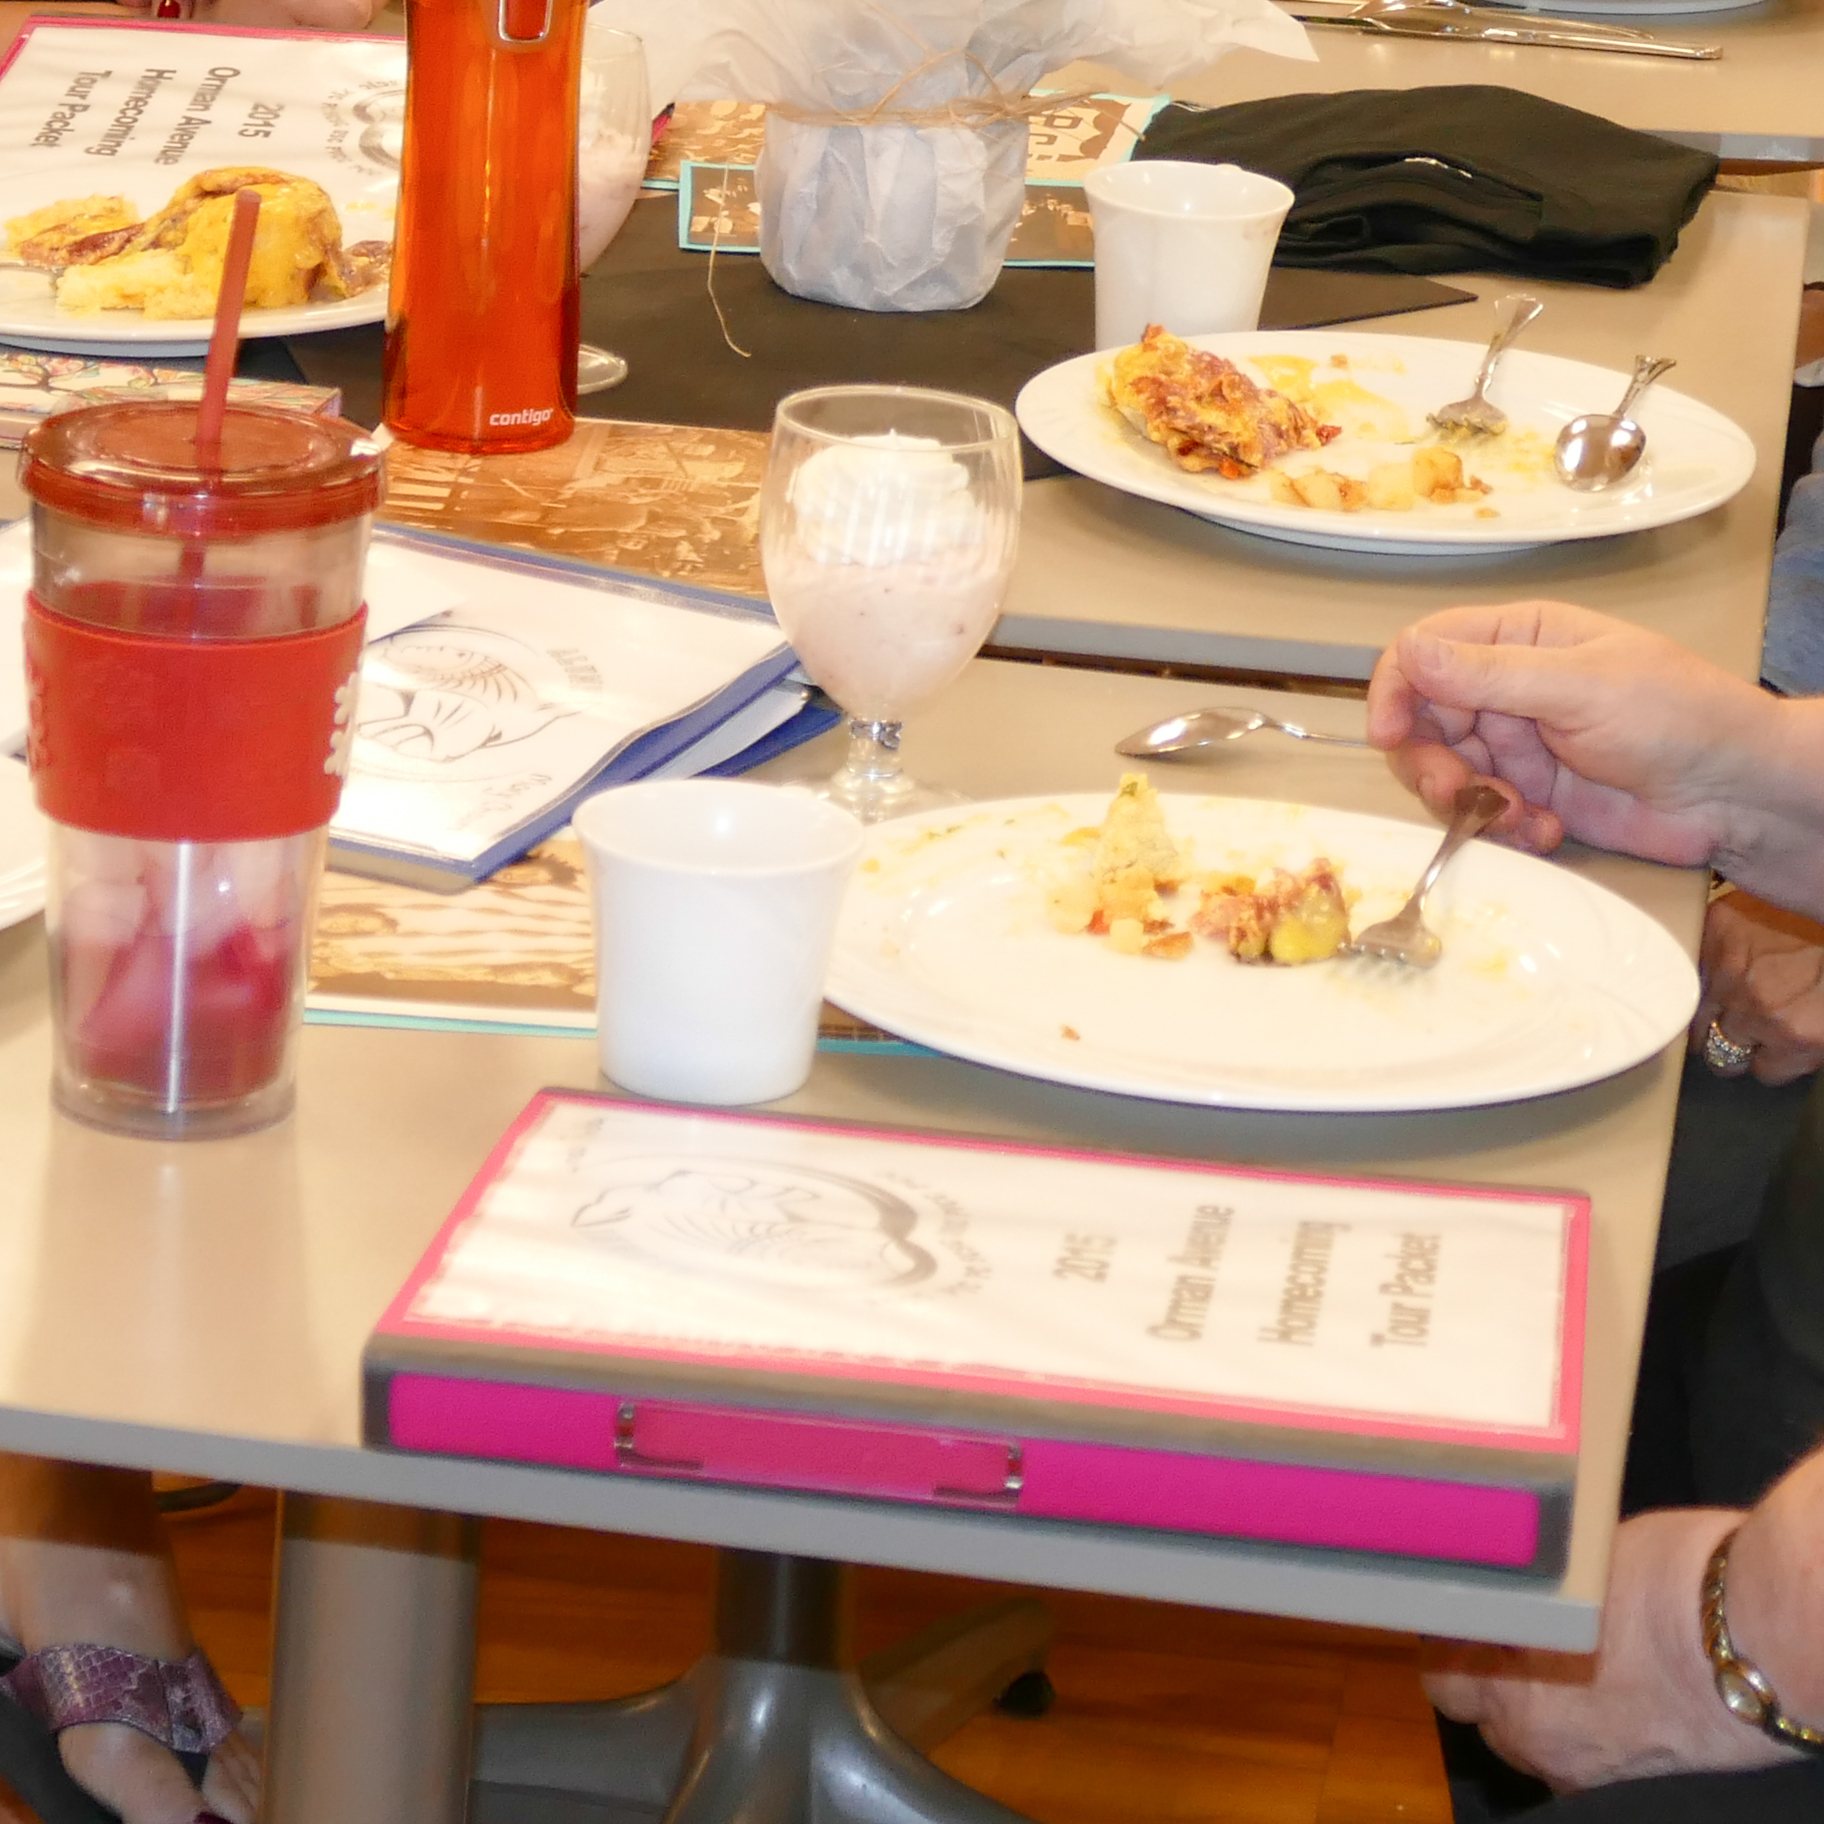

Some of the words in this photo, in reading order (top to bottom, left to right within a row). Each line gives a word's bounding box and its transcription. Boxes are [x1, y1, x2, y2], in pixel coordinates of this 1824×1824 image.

[63, 69, 113, 101] Tour
[185, 66, 241, 113] Orman
[29, 102, 92, 148] Packet
[84, 68, 177, 157] Homecoming
[238, 101, 285, 138] 2015
[154, 115, 213, 166] Avenue
[489, 407, 552, 426] contigo
[1051, 1231, 1119, 1284] 2015
[1377, 1230, 1443, 1300] Packet
[1145, 1274, 1219, 1342] Orman
[1256, 1219, 1353, 1349] Homecoming
[1368, 1301, 1433, 1348] Tour
